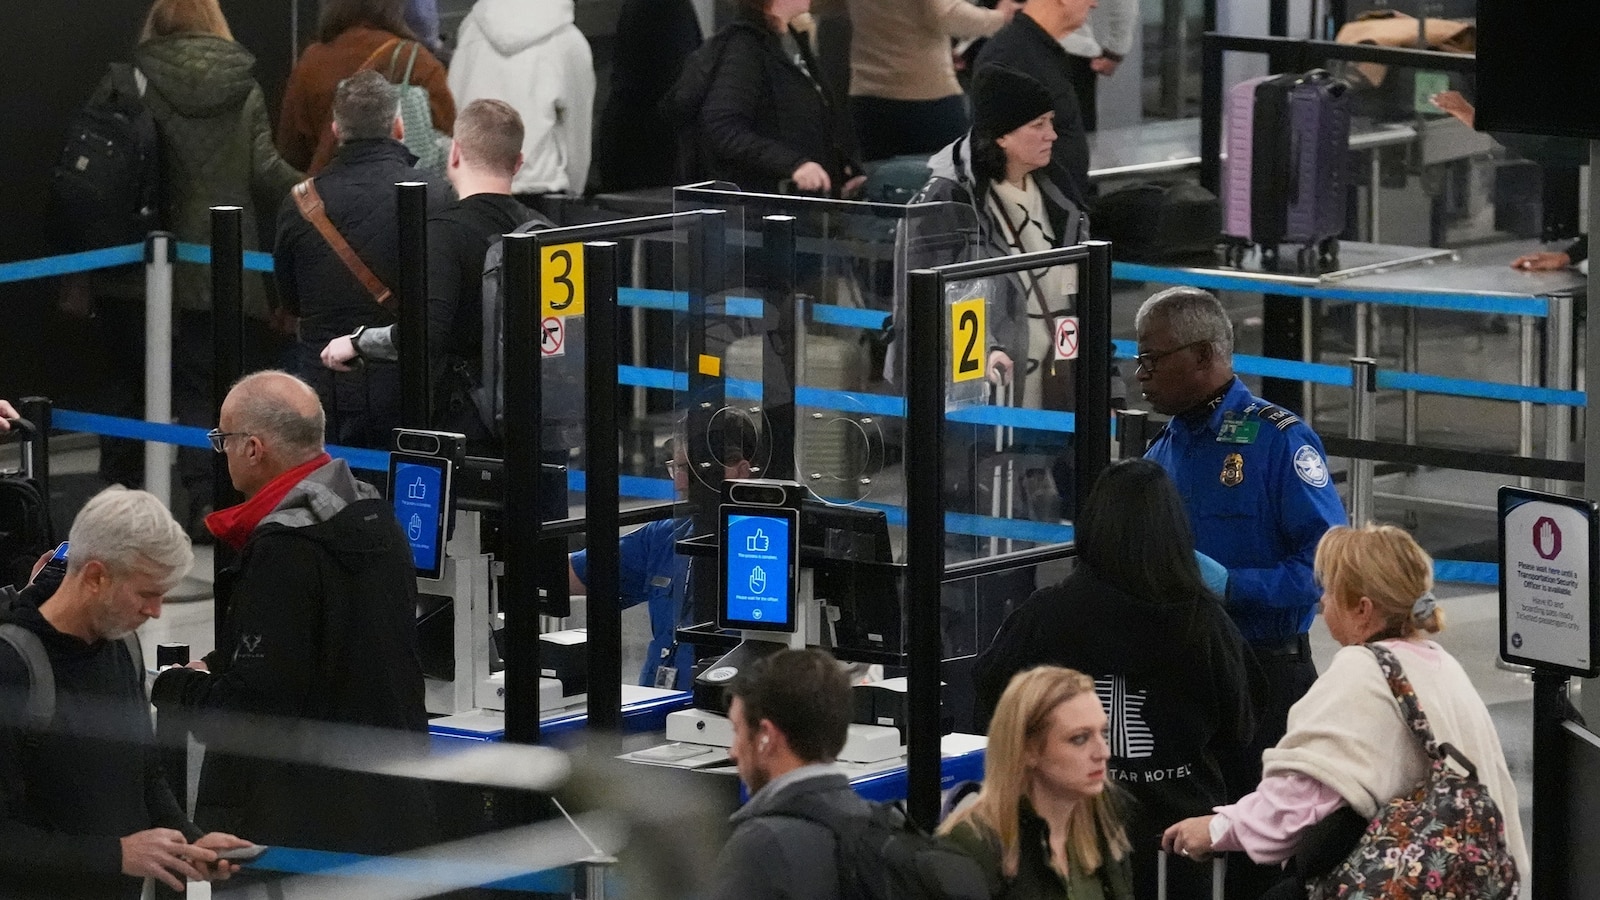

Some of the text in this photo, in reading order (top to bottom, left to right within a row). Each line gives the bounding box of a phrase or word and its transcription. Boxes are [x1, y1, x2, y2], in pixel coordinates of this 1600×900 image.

[550, 249, 575, 311] 3
[958, 309, 979, 374] 2
[1207, 394, 1226, 410] TS
[1268, 410, 1288, 421] TSA
[1518, 561, 1535, 571] Please
[1548, 567, 1560, 575] here
[1561, 569, 1573, 578] until
[1517, 570, 1579, 589] Transportation Security
[1523, 580, 1541, 590] Officer
[1548, 585, 1572, 596] available.
[1521, 604, 1545, 616] boarding
[1532, 597, 1547, 606] Have
[1555, 600, 1564, 609] and
[1516, 611, 1538, 622] Ticketed
[1538, 617, 1567, 629] passengers
[1109, 764, 1191, 783] TAR HOTEL
